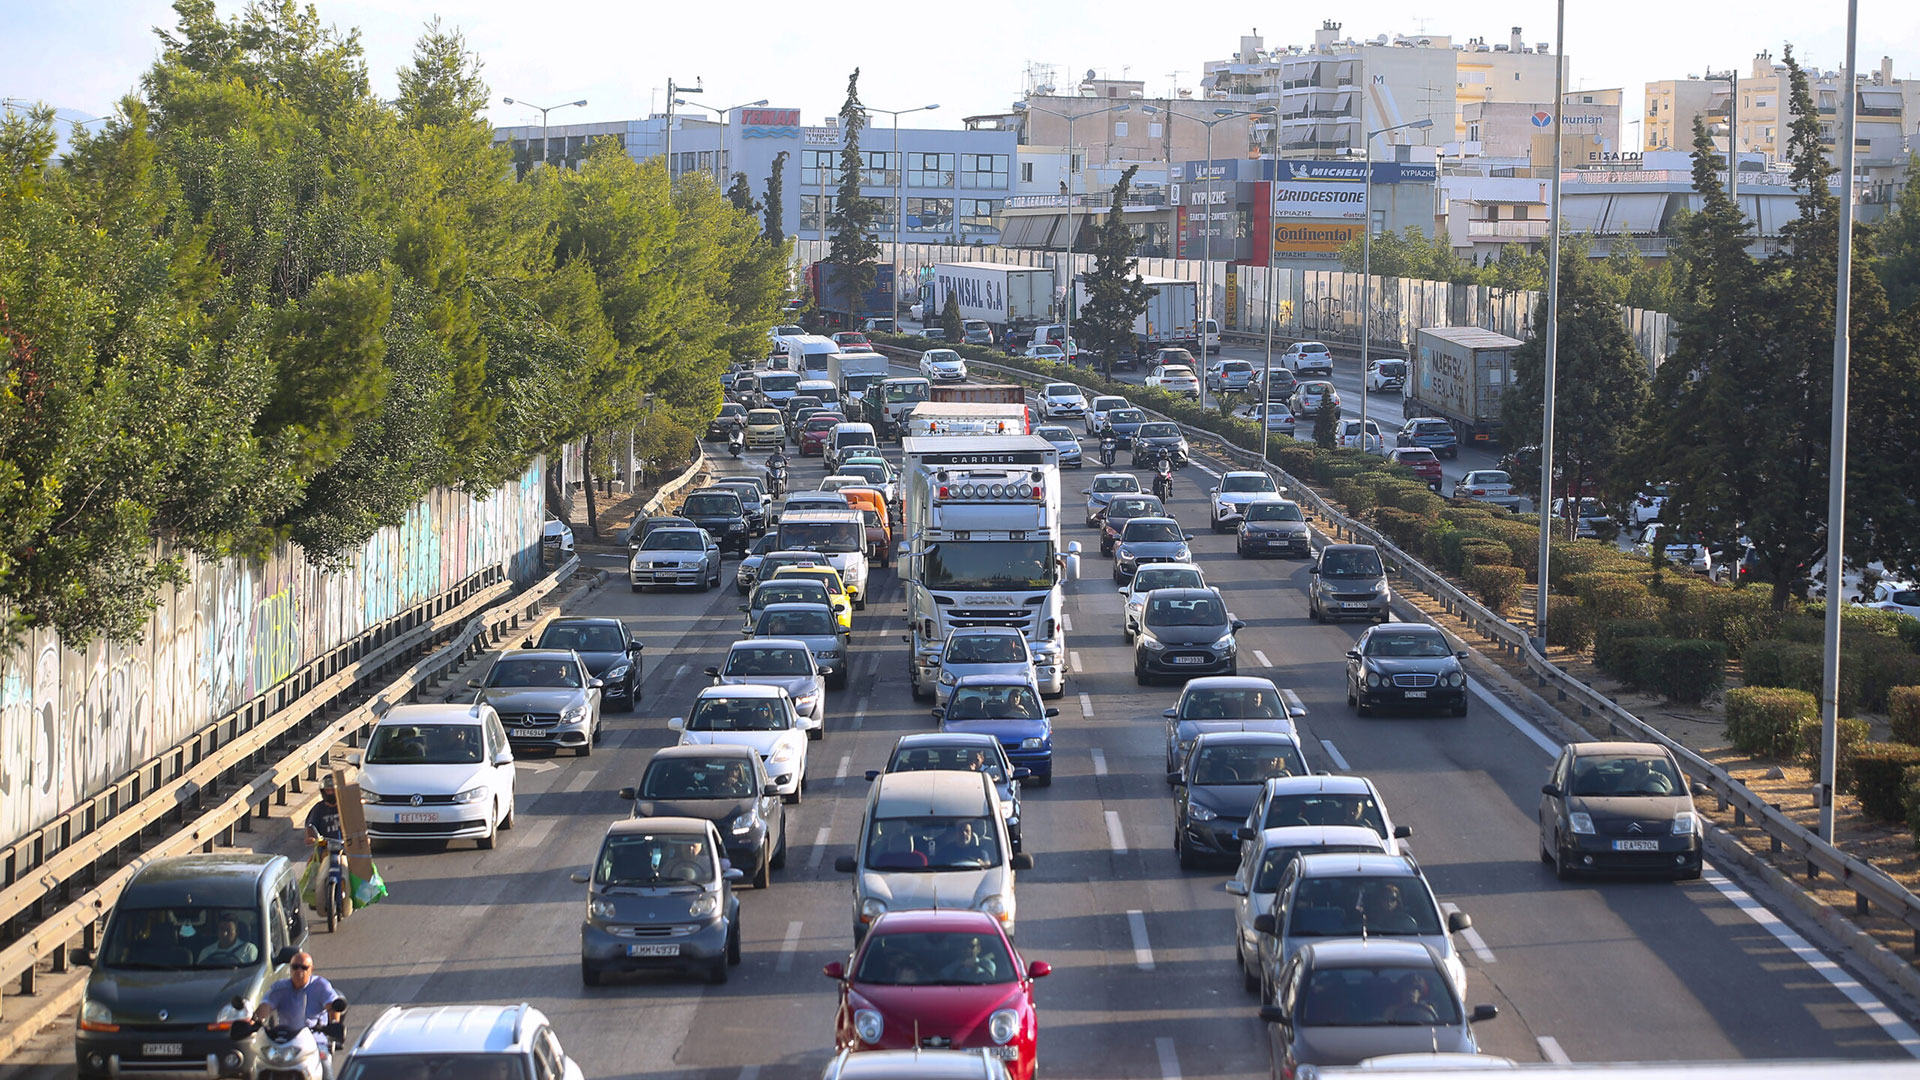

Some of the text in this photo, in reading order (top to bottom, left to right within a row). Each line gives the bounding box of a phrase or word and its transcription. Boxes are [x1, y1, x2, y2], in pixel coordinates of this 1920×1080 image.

[741, 110, 800, 126] TEMAK
[1553, 114, 1603, 125] hunlan
[1202, 166, 1226, 175] MCHELIN
[1191, 191, 1227, 205] ΚΥΡΙΖΗΣ
[1275, 226, 1352, 243] Continental
[951, 455, 1015, 464] CARRIER
